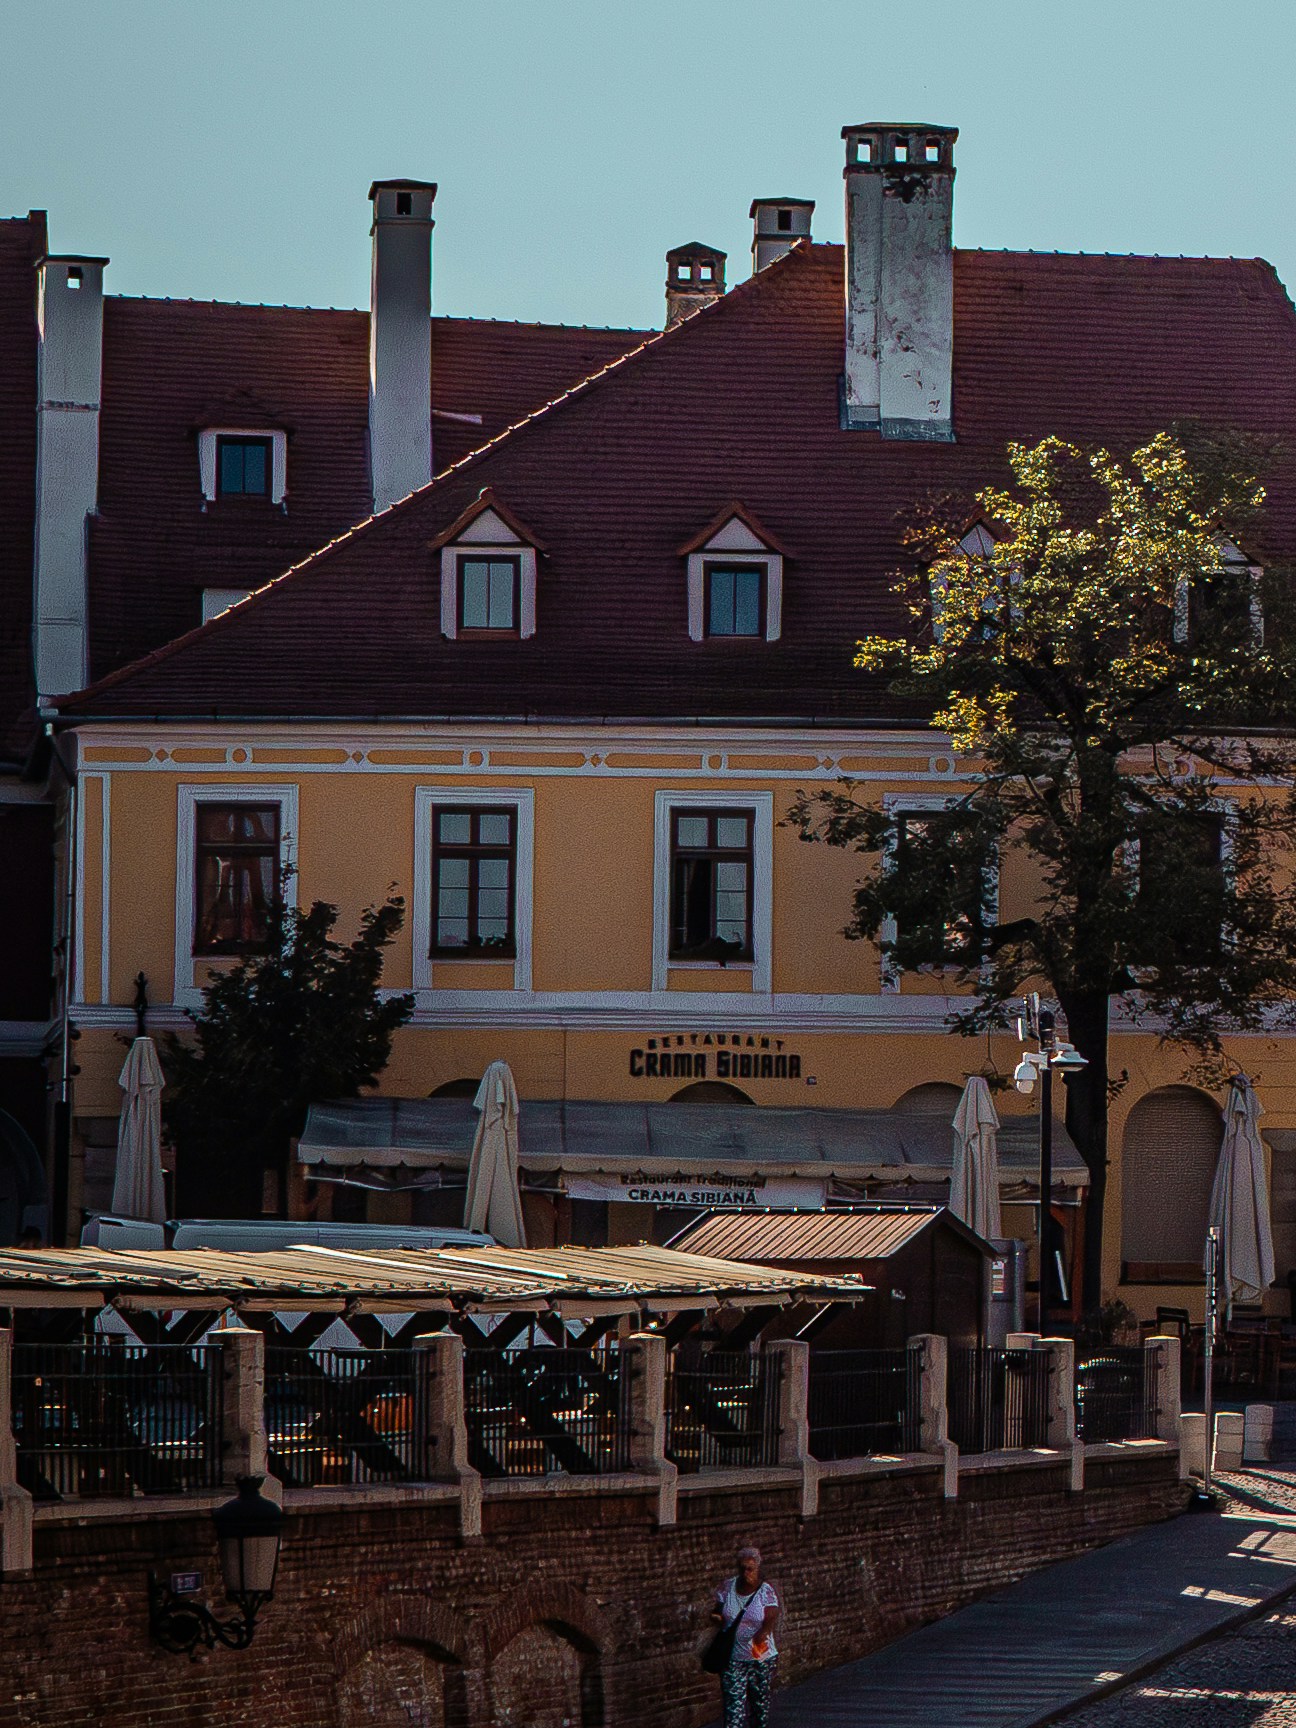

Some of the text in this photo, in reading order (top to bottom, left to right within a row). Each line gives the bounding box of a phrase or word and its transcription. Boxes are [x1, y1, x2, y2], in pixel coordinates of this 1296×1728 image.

[648, 1034, 784, 1052] RESTAURANT
[629, 1189, 757, 1204] CRAMA SIBIANĂ
